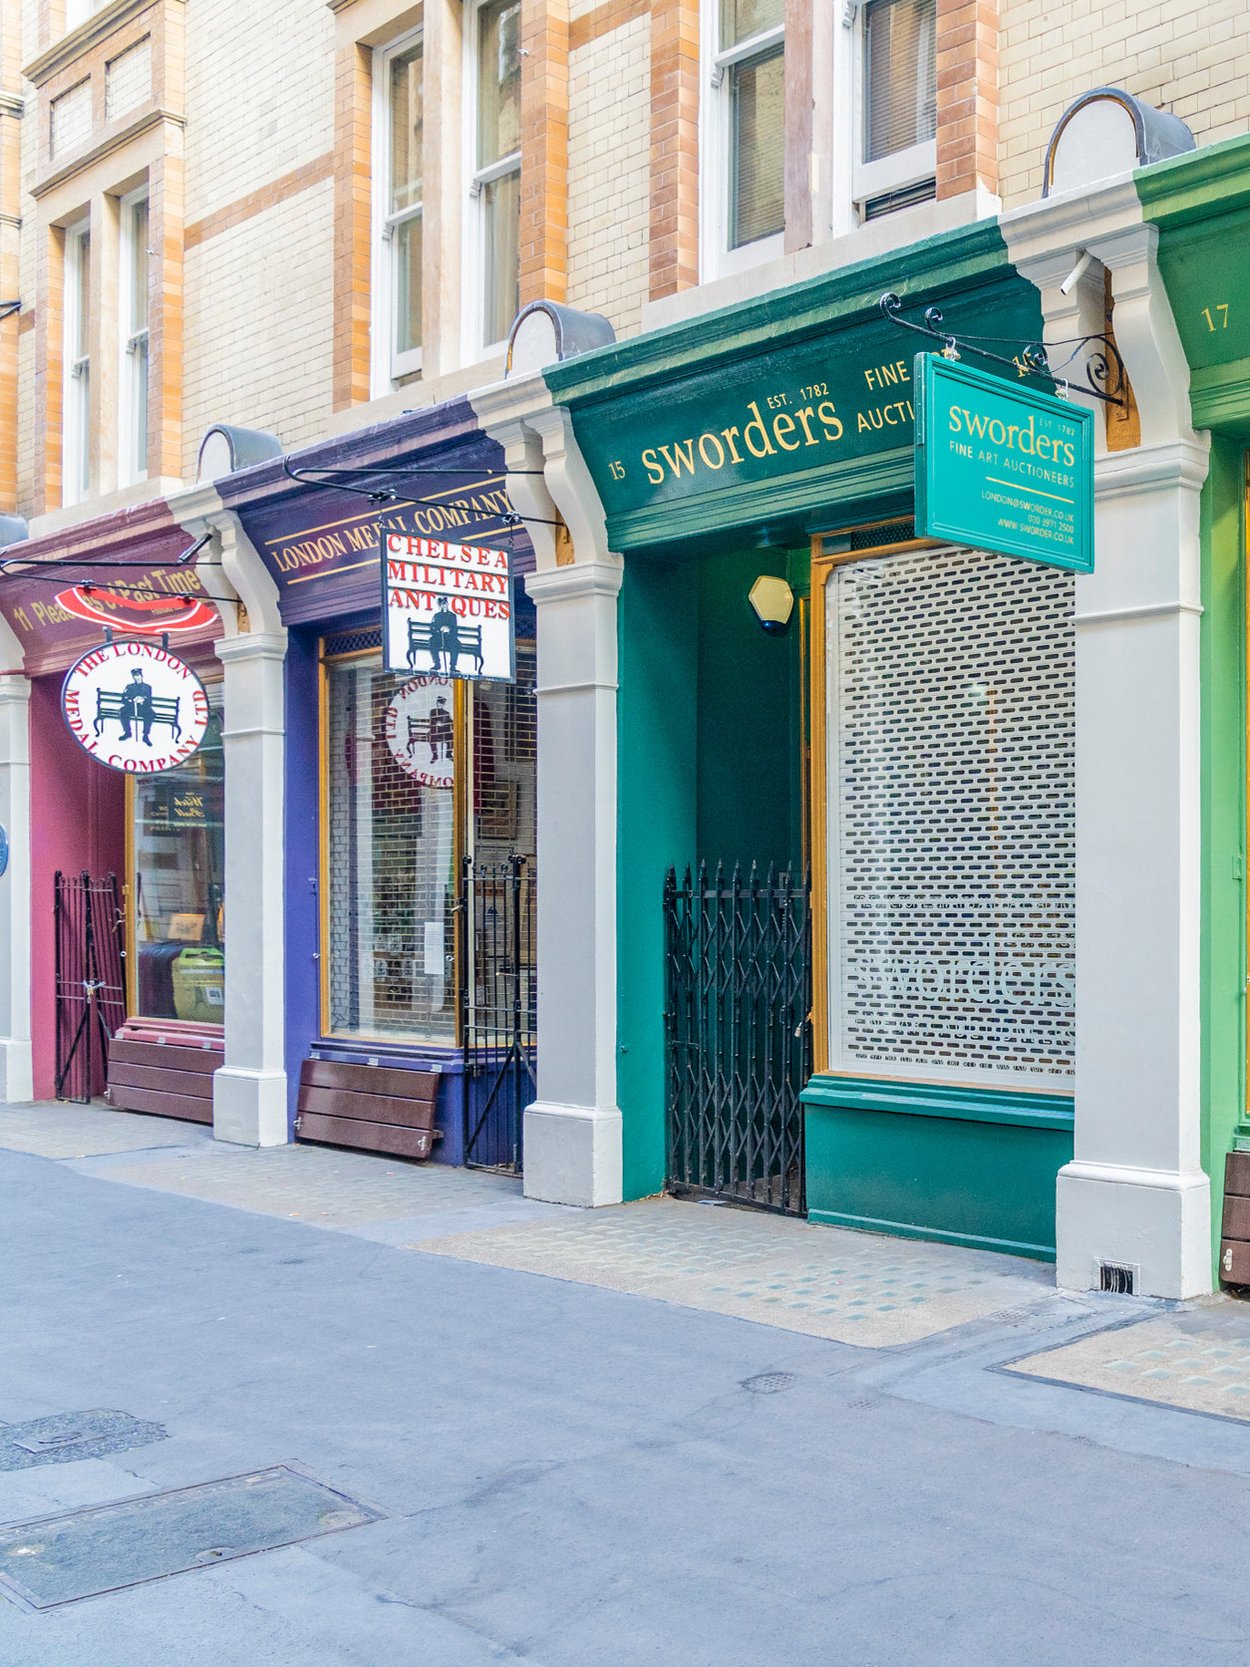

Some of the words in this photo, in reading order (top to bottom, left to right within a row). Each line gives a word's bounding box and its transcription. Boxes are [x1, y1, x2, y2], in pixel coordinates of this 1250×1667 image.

[1201, 303, 1229, 332] 17
[864, 360, 911, 391] FINE
[767, 393, 793, 409] EST.
[800, 382, 829, 400] 1782
[608, 461, 626, 480] 15
[641, 400, 844, 484] sworders
[949, 405, 1075, 467] sworders
[950, 441, 974, 459] FINE
[978, 450, 999, 465] ART
[1003, 458, 1075, 488] AUCTIONEERS
[271, 532, 349, 573] LONDON
[414, 488, 512, 535] COMPANY
[387, 533, 509, 569] CHELSEA
[387, 560, 509, 594] MILITARY
[14, 609, 35, 632] 11
[150, 568, 202, 598] Time
[389, 588, 511, 620] ANTQUES
[74, 648, 110, 679] THE
[112, 642, 193, 680] LONDON
[65, 688, 99, 756] MEDAL
[108, 734, 200, 773] COMPANY
[192, 689, 209, 727] LTD
